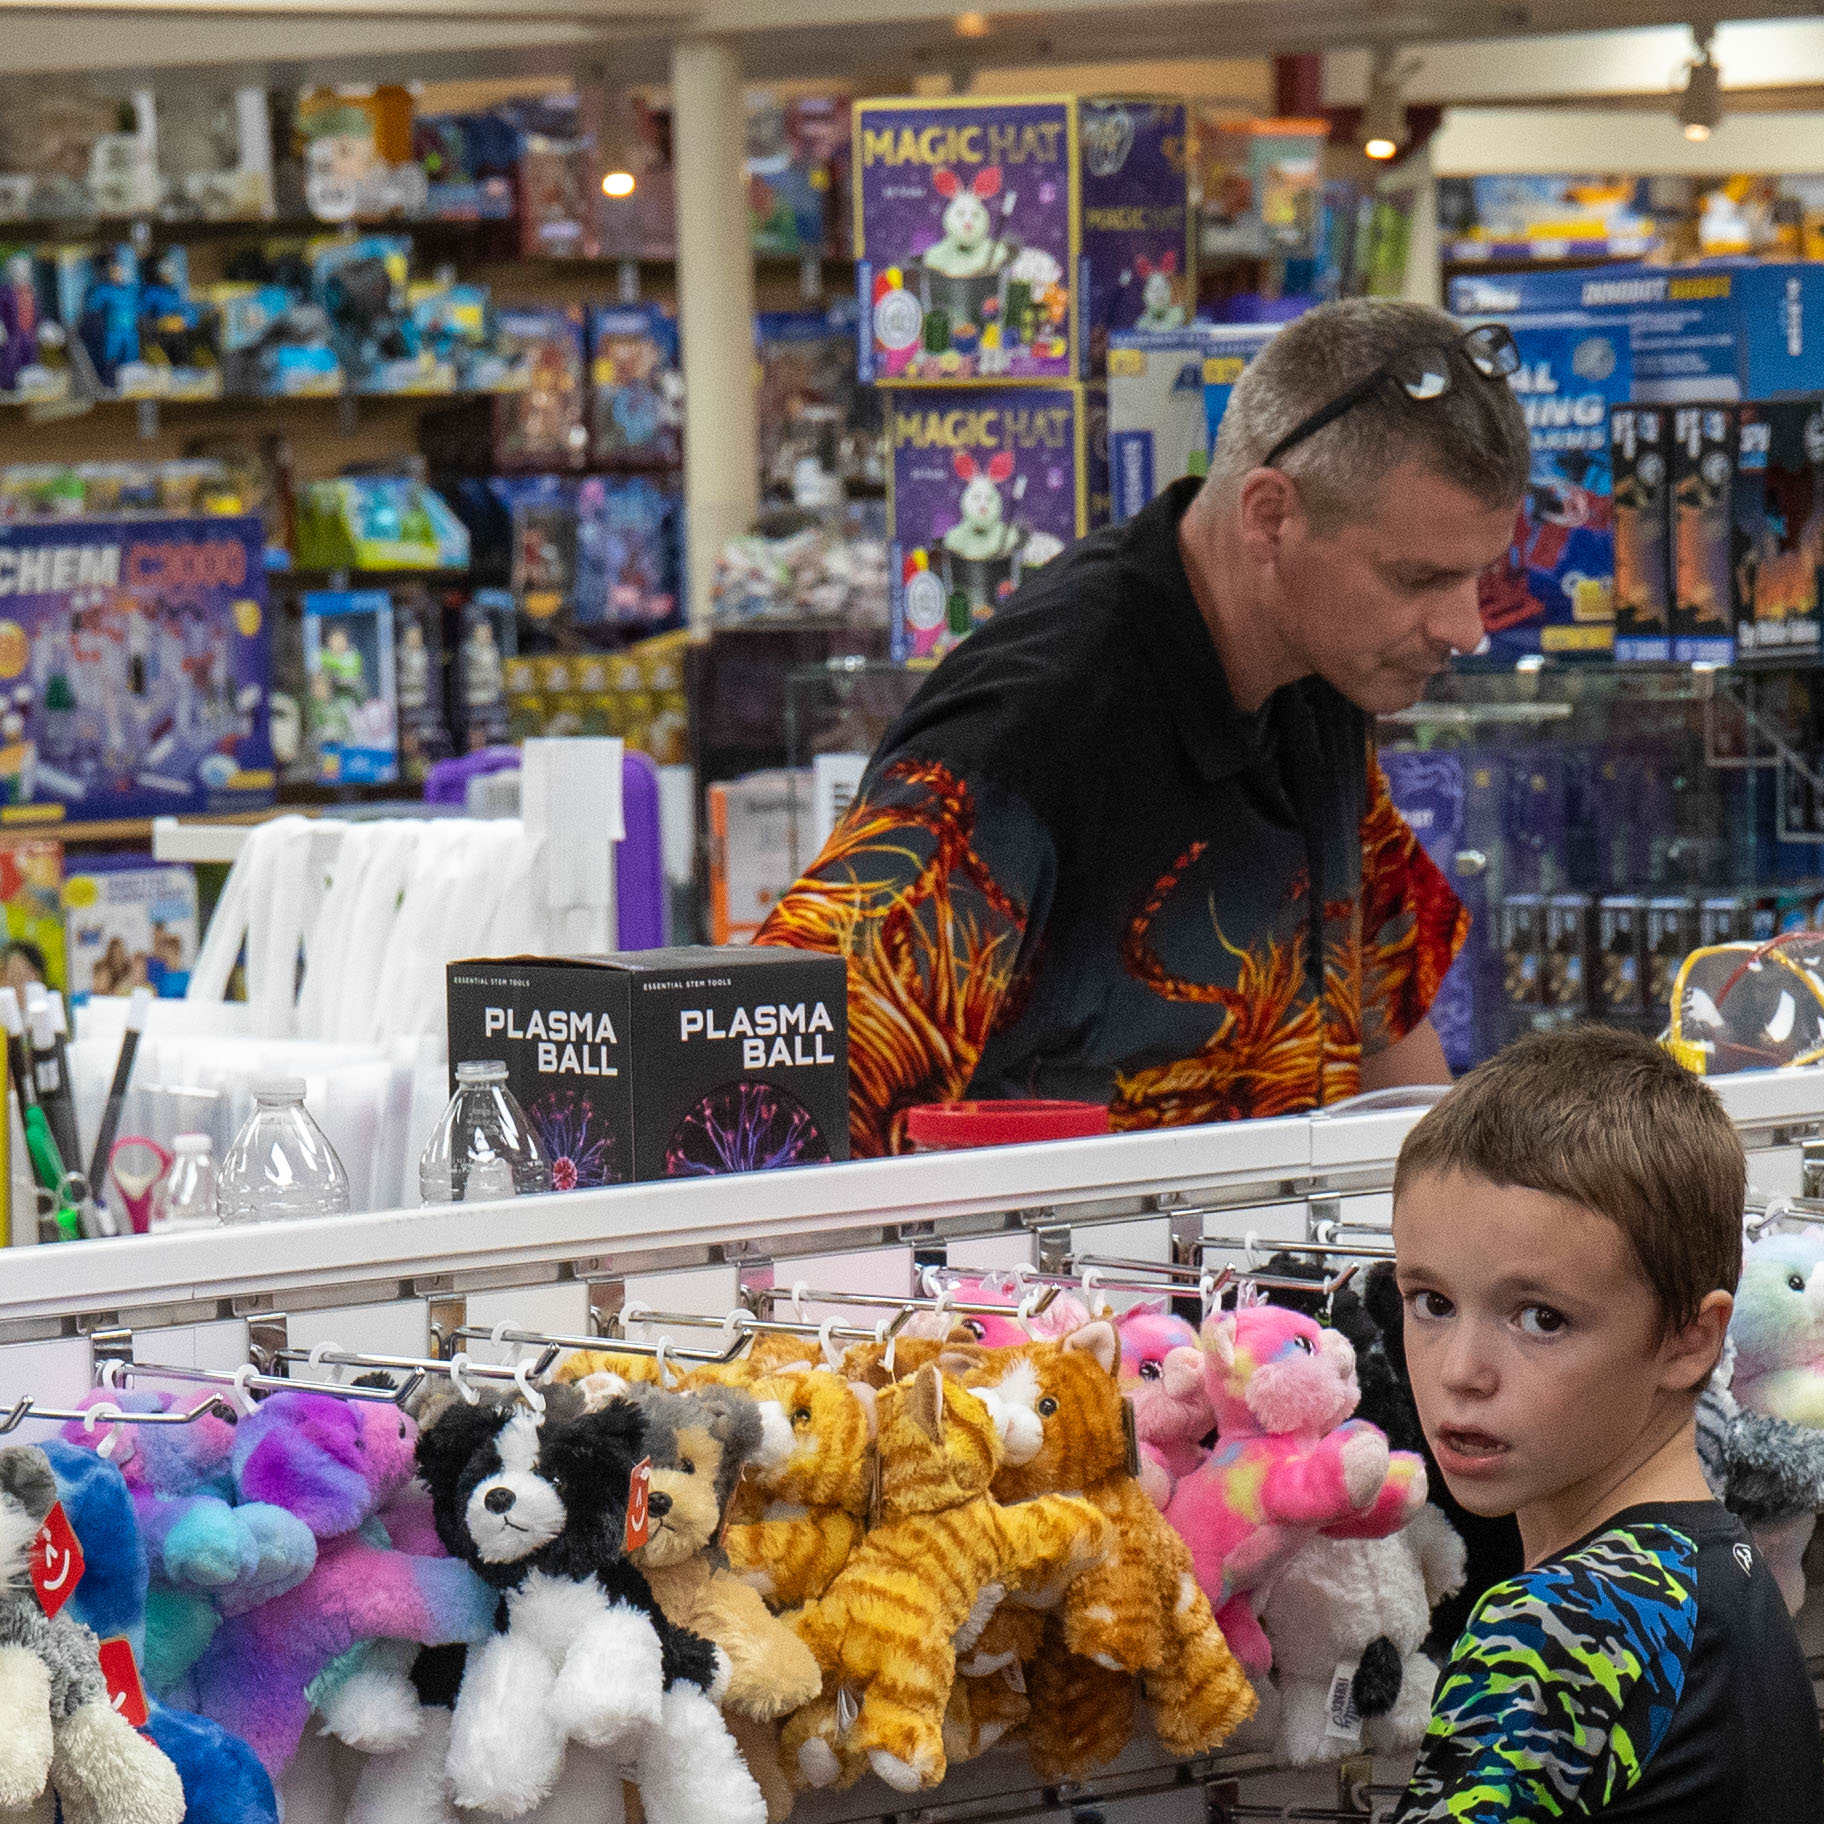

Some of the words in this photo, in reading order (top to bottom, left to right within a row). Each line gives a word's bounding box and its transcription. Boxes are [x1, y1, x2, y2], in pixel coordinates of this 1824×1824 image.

[862, 126, 983, 167] MAGIC
[989, 122, 1062, 165] HAT
[895, 409, 998, 450] MAGIC
[1003, 409, 1071, 448] HAT
[453, 976, 489, 987] ESSENTIAL
[491, 978, 508, 987] STEM
[509, 978, 531, 988] TOOLS
[643, 981, 683, 992] ESSENTIAL
[686, 980, 705, 990] STEM
[707, 978, 732, 988] TOOLS
[485, 1006, 618, 1044] PLASMA
[680, 1002, 835, 1042] PLASMA
[538, 1041, 618, 1076] BALL
[742, 1034, 835, 1070] BALL
